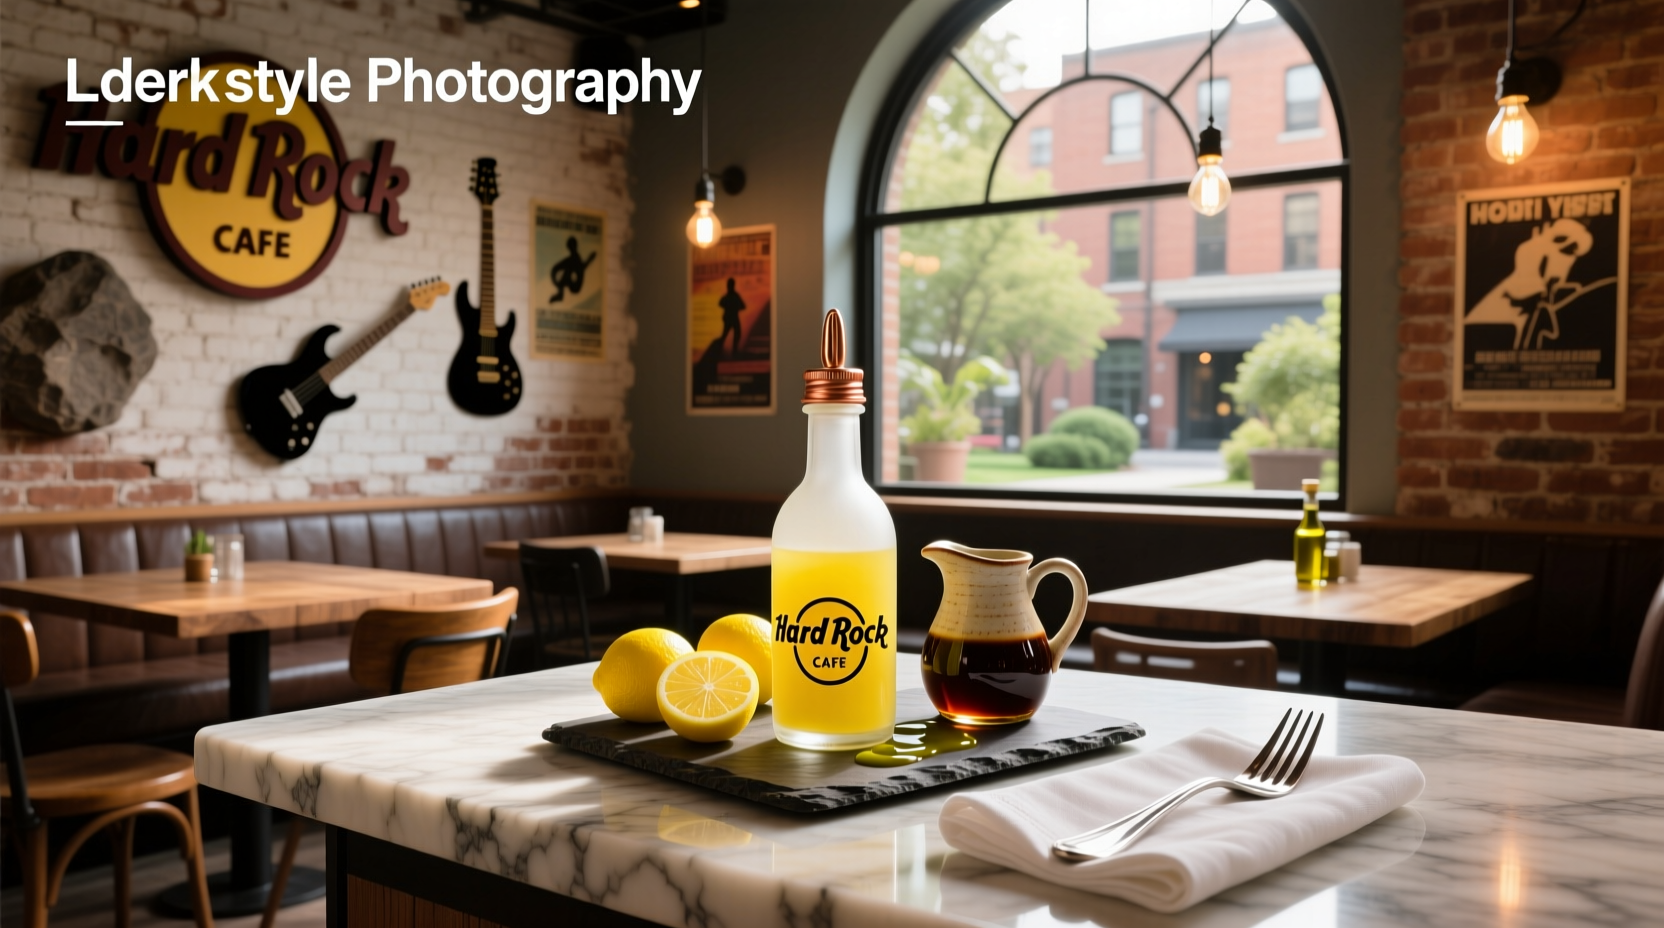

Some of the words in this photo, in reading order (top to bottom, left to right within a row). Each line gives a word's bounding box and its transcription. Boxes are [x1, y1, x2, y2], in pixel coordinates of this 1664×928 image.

[33, 82, 249, 192] Hard
[245, 120, 411, 236] Rock
[213, 225, 291, 258] CAFE
[775, 614, 830, 645] Hard
[831, 615, 888, 652] Rock
[812, 656, 847, 669] CAFE
